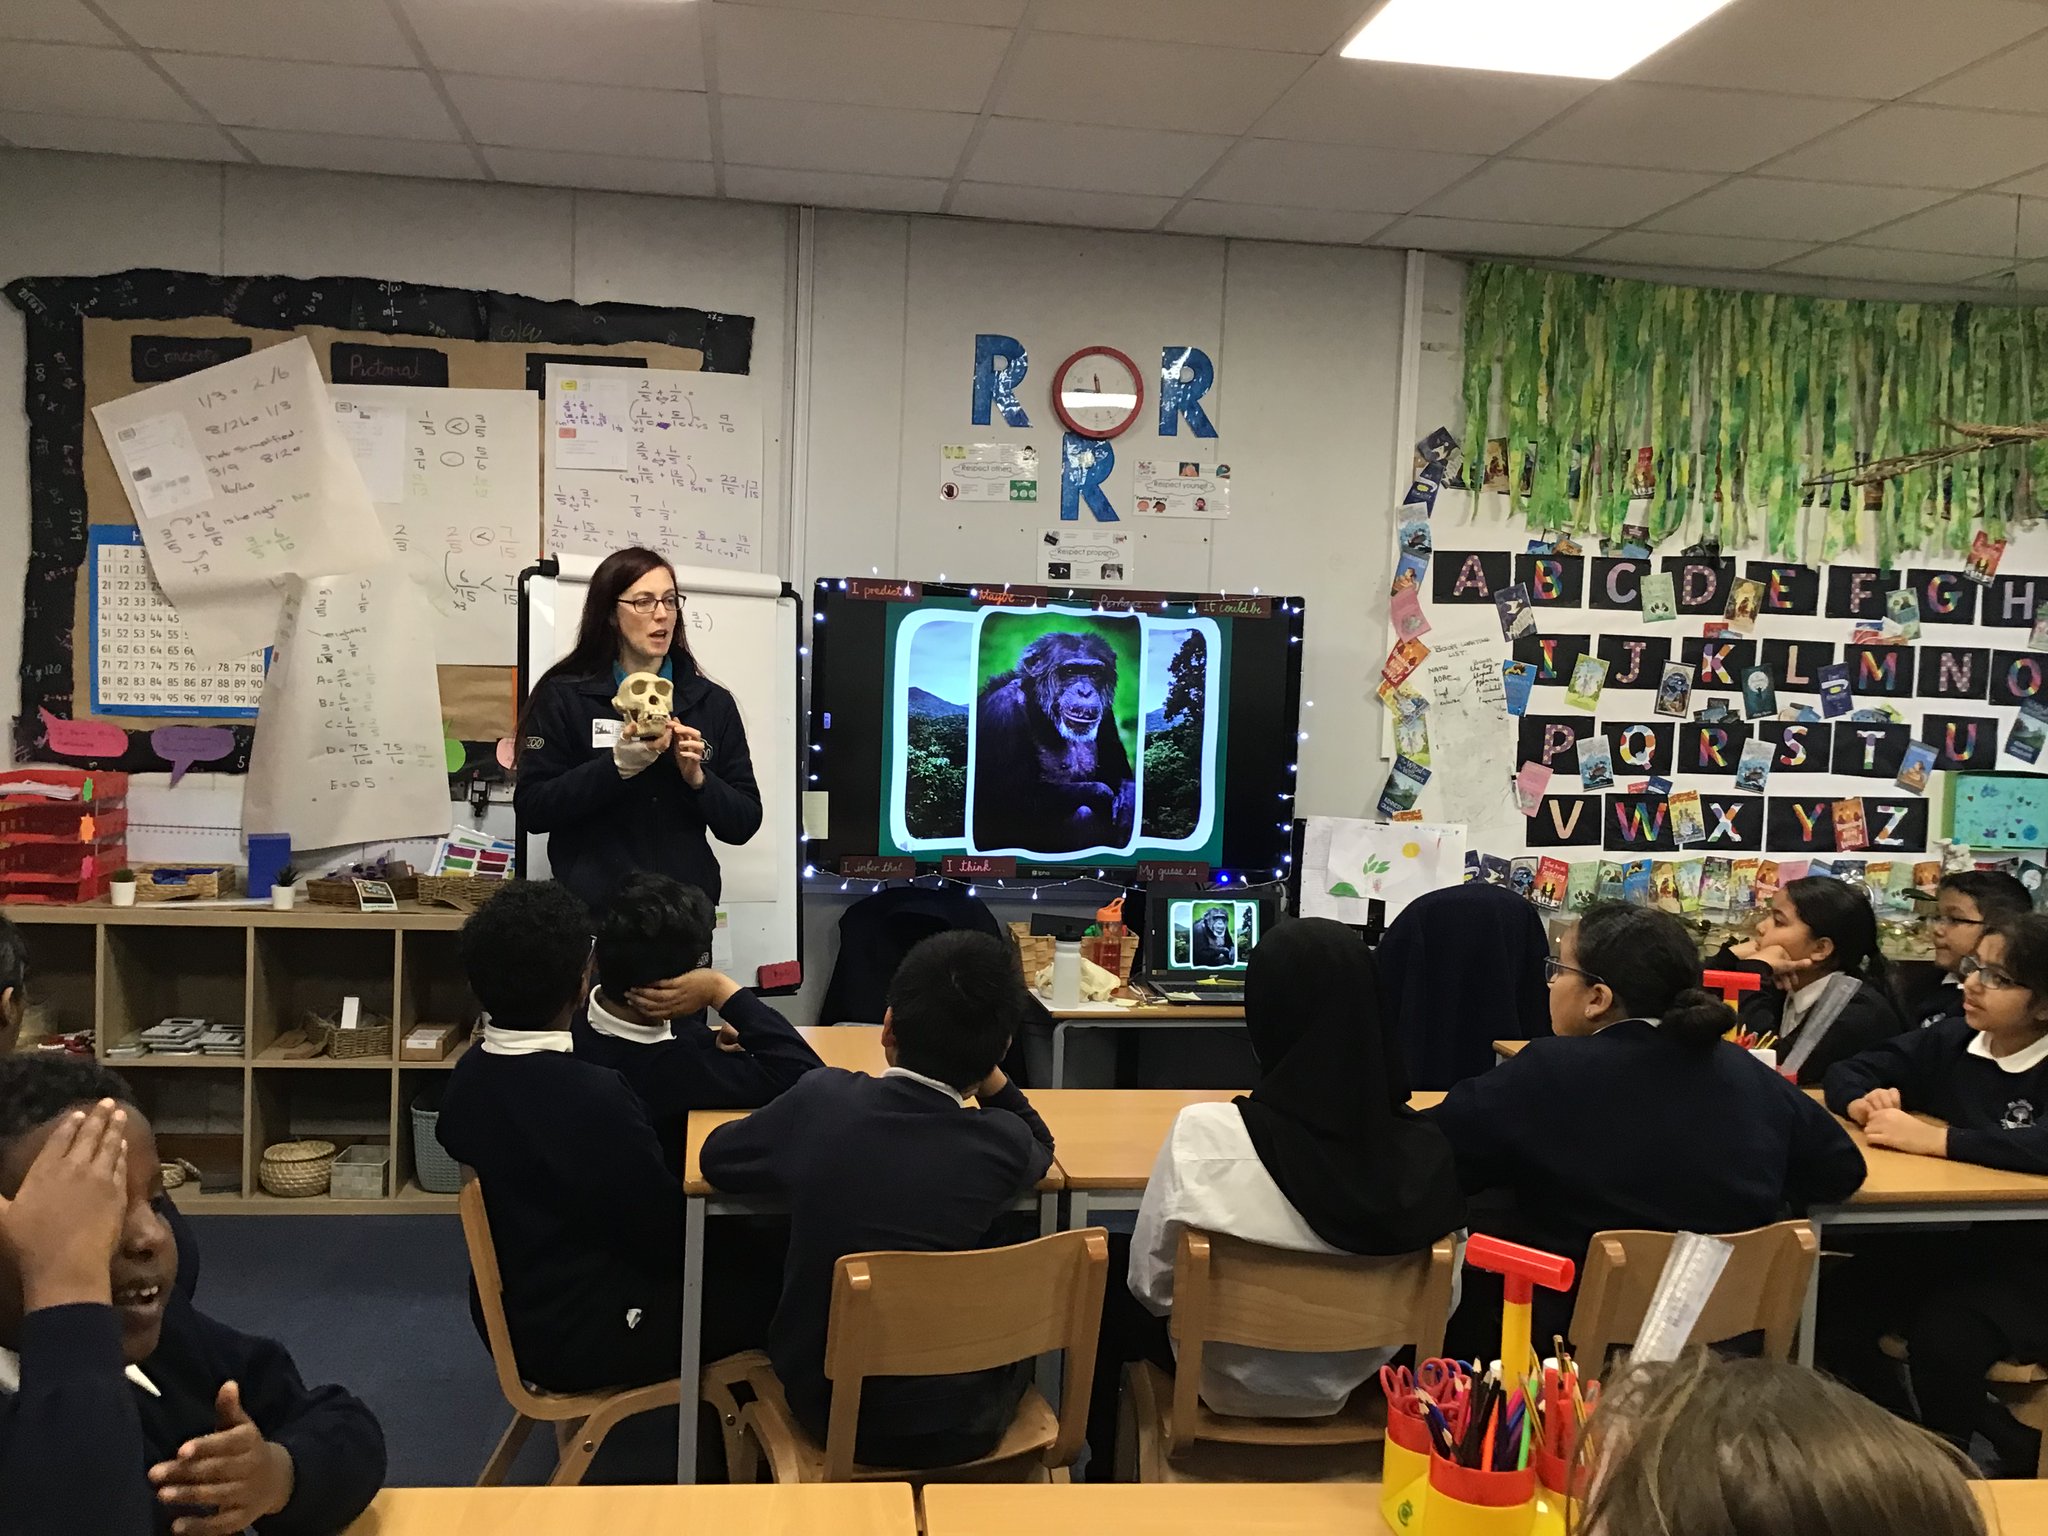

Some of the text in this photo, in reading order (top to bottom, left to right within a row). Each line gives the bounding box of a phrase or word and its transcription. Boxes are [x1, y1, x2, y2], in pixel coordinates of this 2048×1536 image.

[349, 354, 422, 378] Pictorial
[972, 334, 1033, 427] R
[1158, 346, 1219, 438] R
[1060, 432, 1120, 522] R
[124, 549, 129, 559] 2
[104, 565, 146, 575] 11 12 13
[103, 581, 111, 590] 21
[118, 581, 129, 591] 22
[134, 581, 146, 591] 23
[1453, 555, 2036, 619] A B C D E F G H
[102, 597, 162, 607] 31 32 33 34
[1203, 601, 1216, 613] It
[1219, 602, 1249, 614] could
[101, 613, 180, 624] 41 42 43 44 45
[102, 629, 110, 638] 51
[117, 629, 128, 639] 52
[134, 629, 145, 639] 53
[151, 630, 161, 639] 54
[168, 630, 178, 640] 55
[102, 645, 110, 654] 61
[117, 645, 128, 654] 62
[133, 646, 145, 655] 63
[150, 646, 161, 655] 64
[168, 646, 179, 656] 65
[103, 660, 110, 669] 71
[118, 661, 128, 670] 72
[134, 661, 144, 670] 73
[150, 662, 162, 671] 74
[169, 662, 178, 672] 75
[185, 663, 196, 672] 76
[219, 663, 229, 672] 78
[235, 664, 245, 673] 79
[250, 665, 263, 673] 80
[1539, 640, 1558, 679] I
[1615, 641, 1647, 683] J
[1701, 644, 1736, 684] K
[1786, 645, 1809, 684] L
[1859, 651, 1897, 690] M
[1939, 653, 1972, 692] N
[2007, 658, 2042, 697] O
[102, 677, 263, 689] 81 82 83 84 85 86 87 88 89 90
[102, 692, 111, 701] 91
[118, 693, 128, 702] 92
[134, 693, 145, 702] 93
[150, 694, 161, 702] 94
[167, 694, 178, 703] 95
[184, 694, 195, 703] 96
[201, 695, 212, 703] 97
[218, 695, 229, 704] 98
[234, 695, 245, 704] 99
[1542, 724, 1575, 765] P
[1619, 724, 1656, 770] Q
[1700, 728, 1728, 767] R
[1780, 725, 1809, 766] S
[1857, 730, 1886, 769] T
[1946, 723, 1977, 761] U
[237, 755, 245, 768] 5
[1549, 800, 1584, 839] V
[1615, 802, 1668, 841] W
[1707, 803, 1744, 841] X
[1792, 803, 1826, 841] Y
[1874, 805, 1908, 845] Z
[947, 860, 991, 872] I think
[1139, 865, 1154, 881] My
